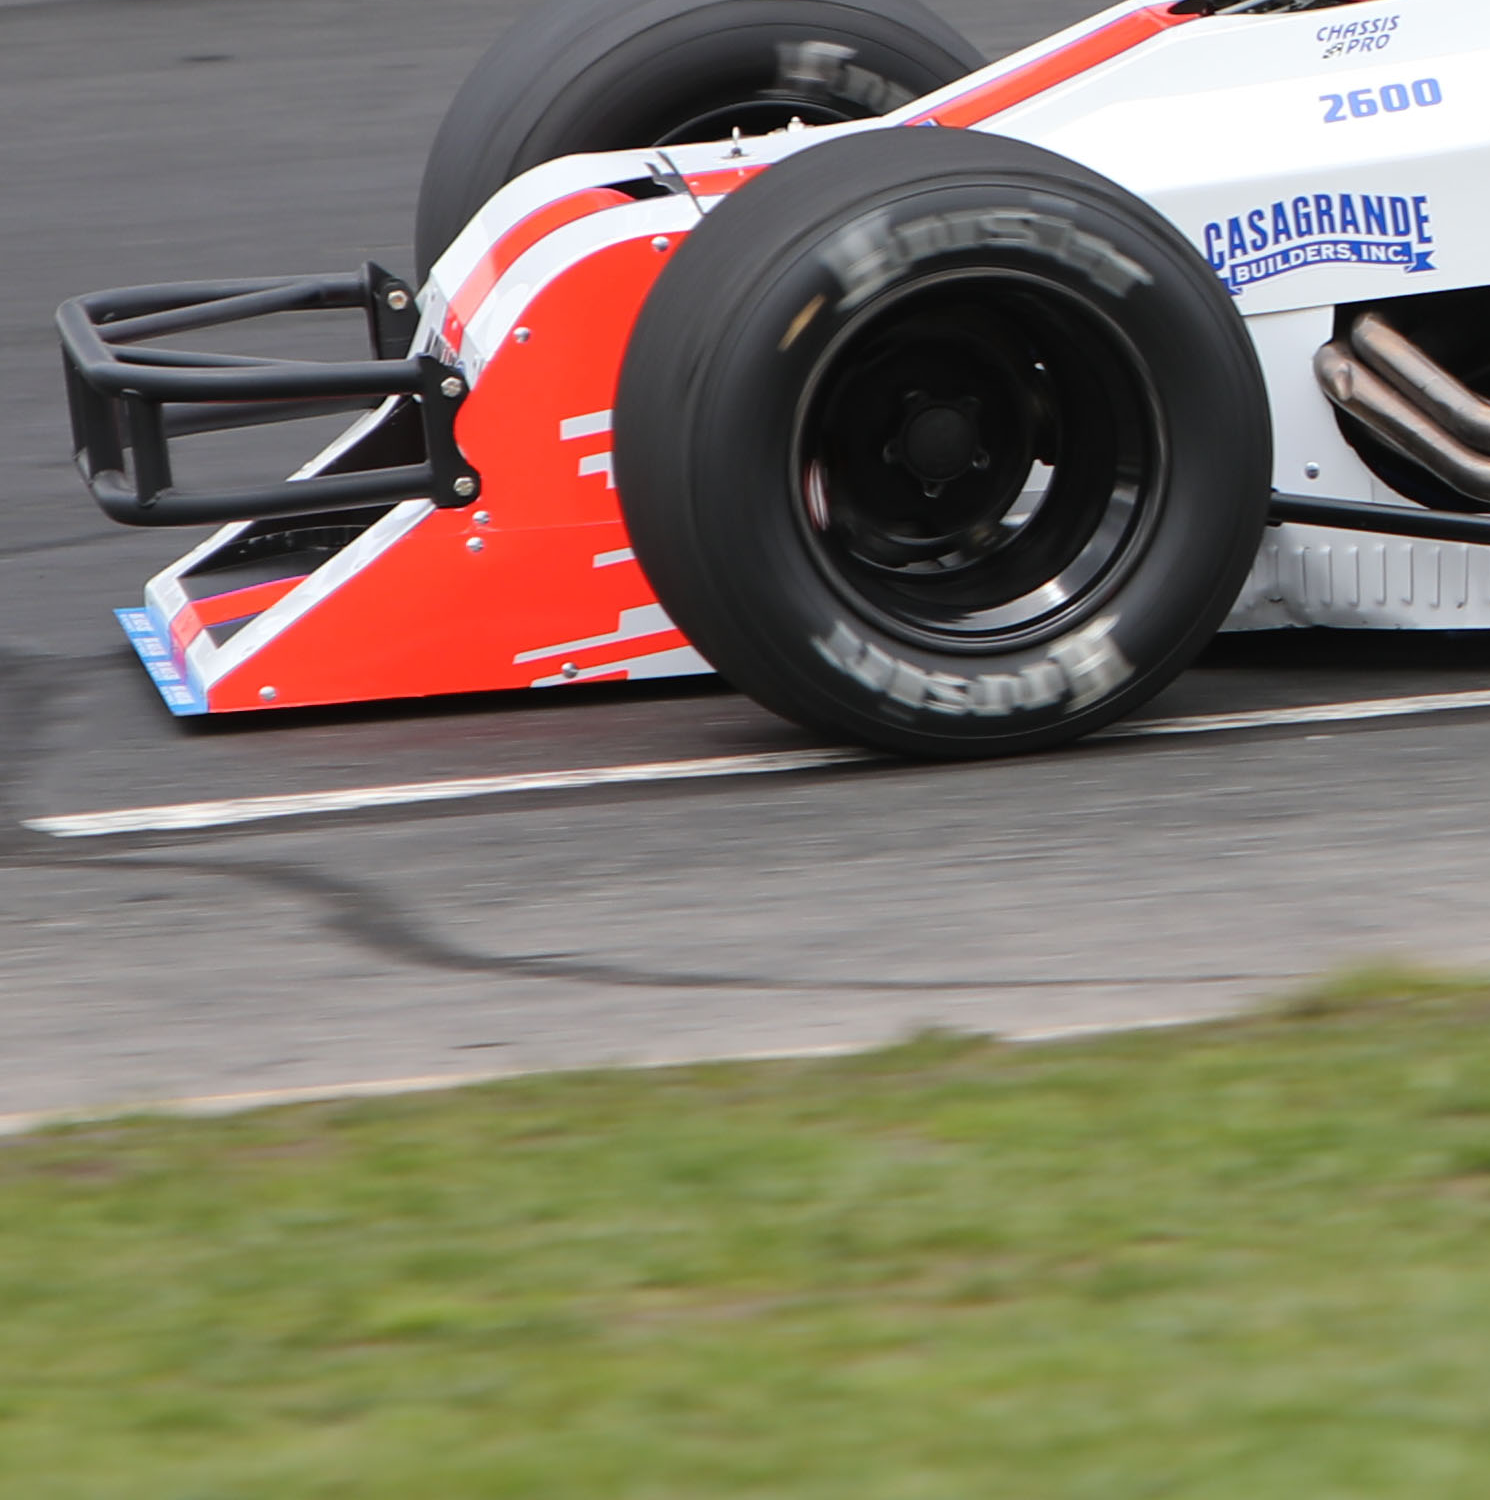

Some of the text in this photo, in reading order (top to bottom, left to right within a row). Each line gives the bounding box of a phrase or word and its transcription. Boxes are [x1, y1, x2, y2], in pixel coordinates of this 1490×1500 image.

[1316, 15, 1400, 42] CHASSIS
[1346, 34, 1390, 54] PRO
[1319, 78, 1443, 123] 2600
[1204, 193, 1433, 272] CASAGRANDE
[1235, 244, 1410, 283] BUILDERS, INC.
